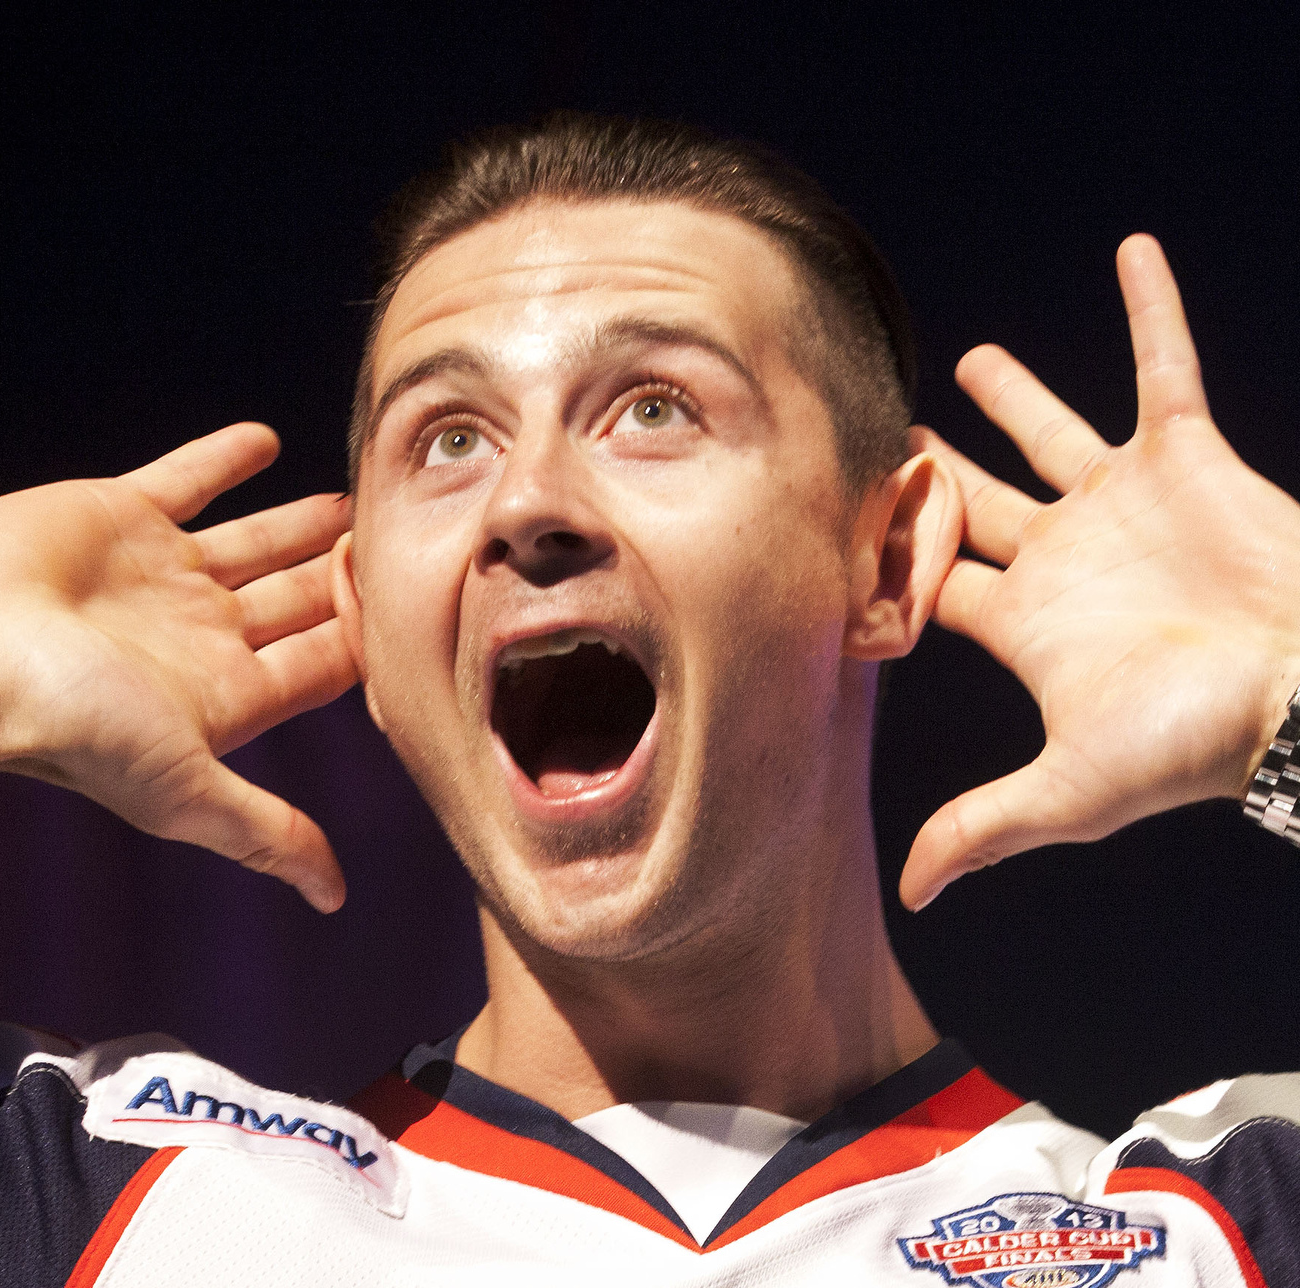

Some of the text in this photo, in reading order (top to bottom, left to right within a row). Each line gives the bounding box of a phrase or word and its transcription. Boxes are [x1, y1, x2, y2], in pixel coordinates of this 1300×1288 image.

[124, 1075, 379, 1169] Amway
[960, 1211, 1104, 1236] 20 13
[942, 1229, 1132, 1258] CALDER CUP
[984, 1248, 1093, 1268] FINALS
